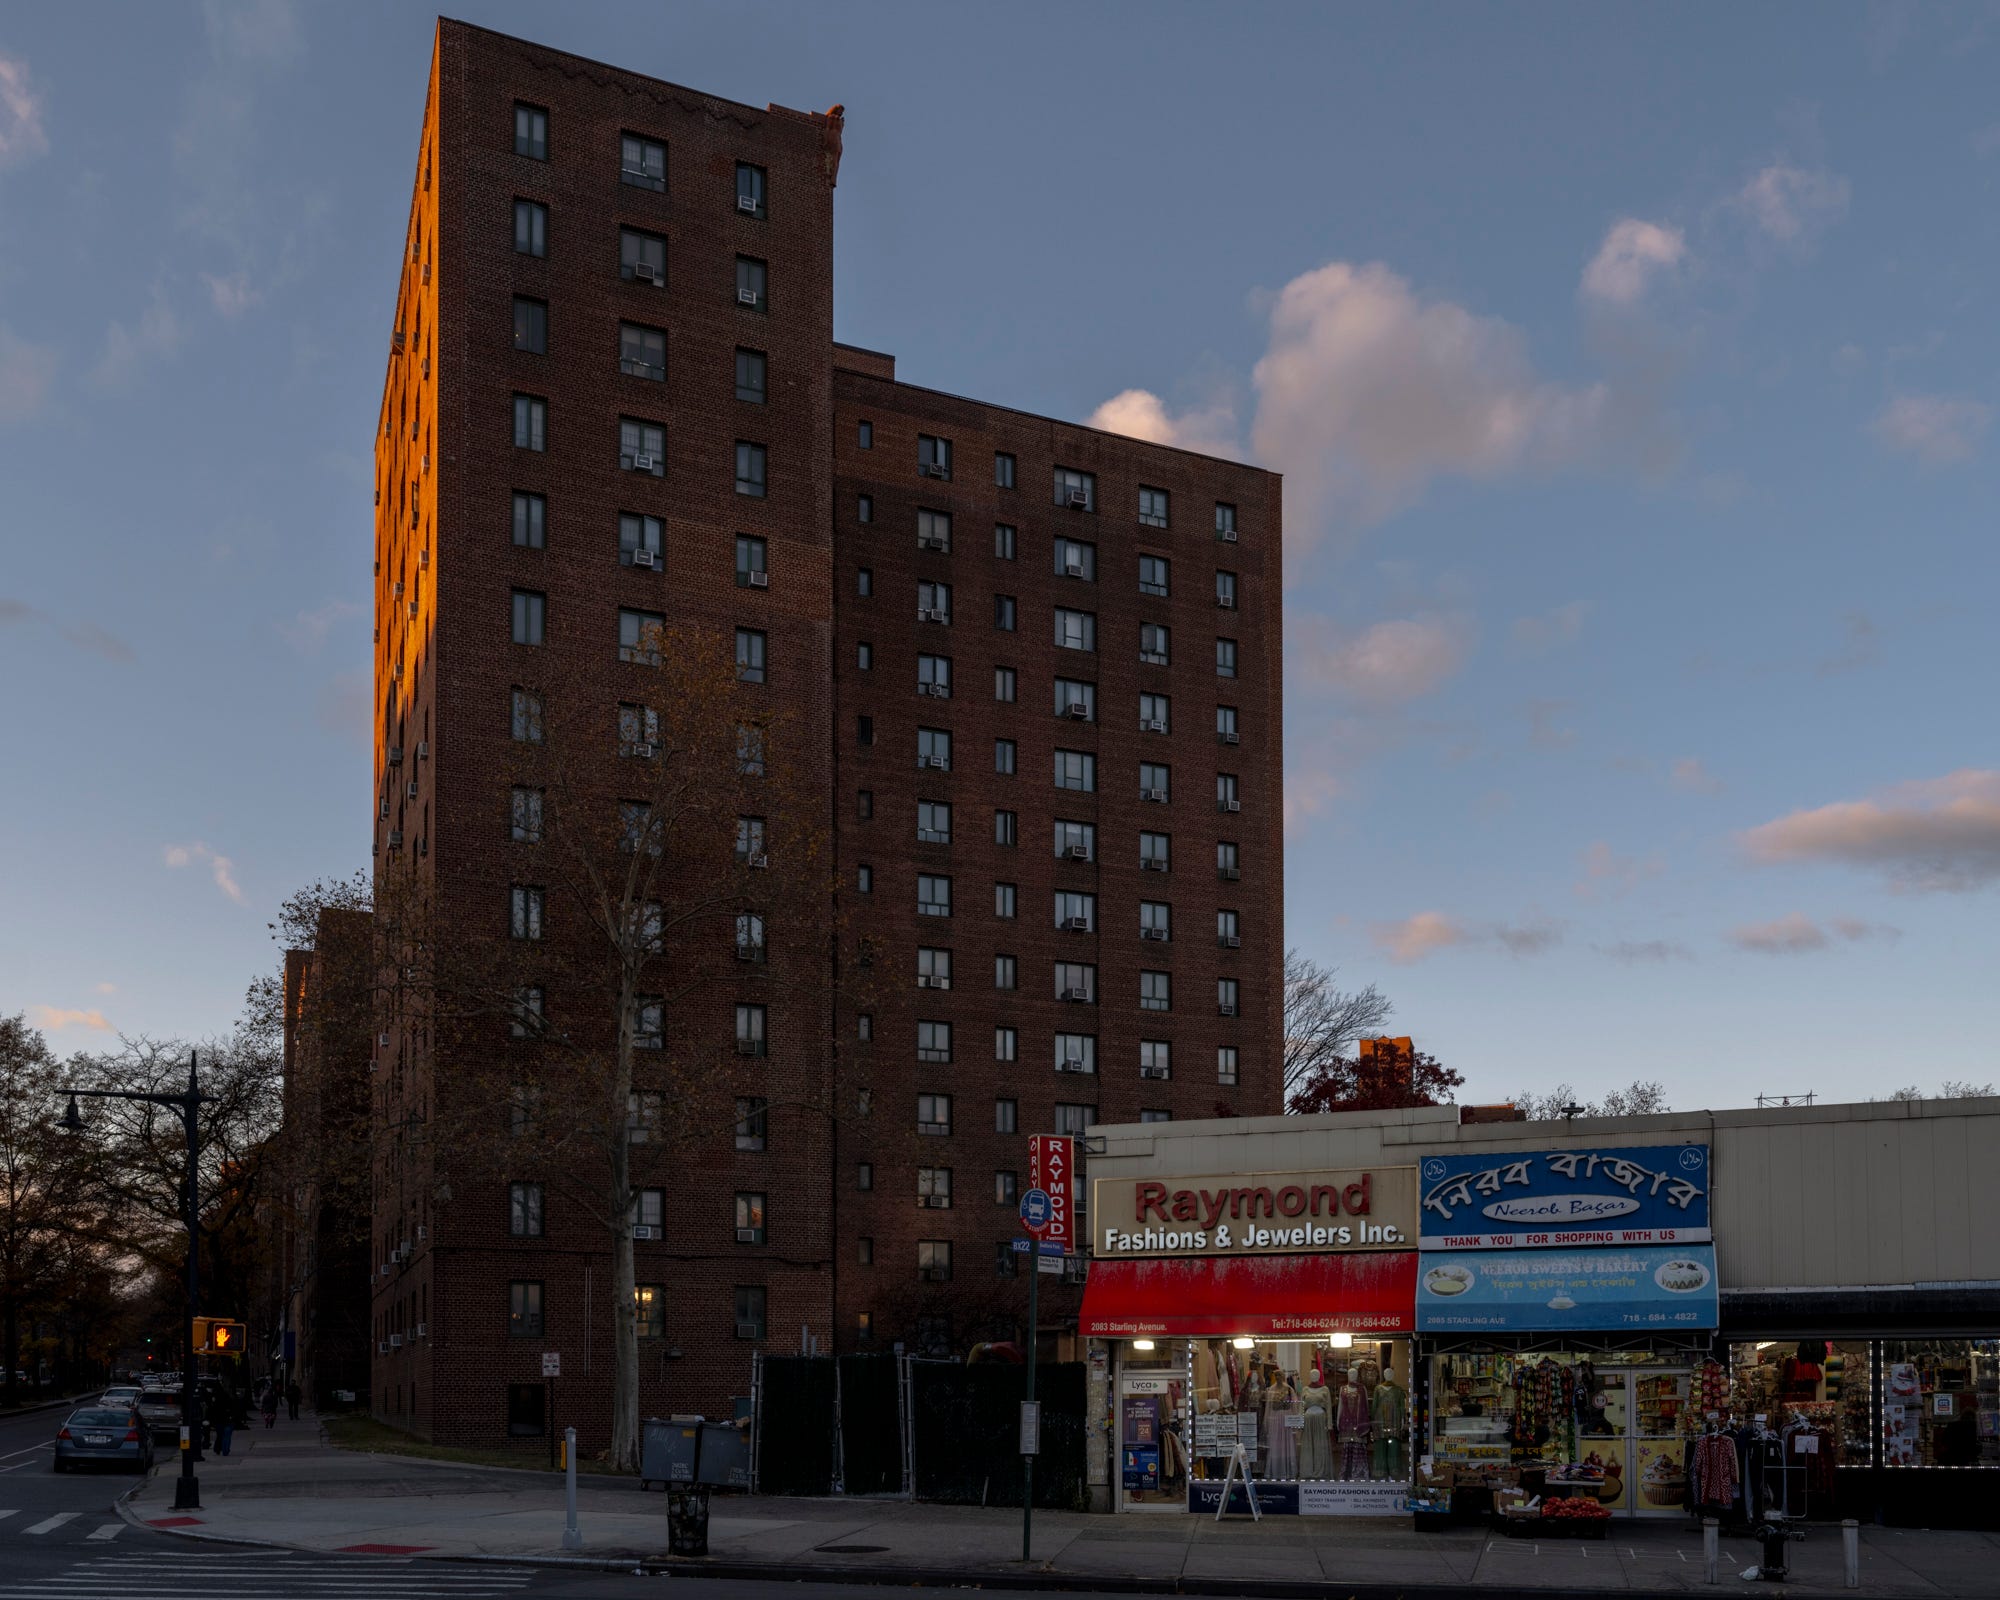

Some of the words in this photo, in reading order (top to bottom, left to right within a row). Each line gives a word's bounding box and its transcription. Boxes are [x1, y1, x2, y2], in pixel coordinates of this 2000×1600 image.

[1048, 1140, 1064, 1235] RAYMOND
[1546, 1153, 1704, 1210] বাজার
[1135, 1173, 1372, 1230] Raymond
[1105, 1226, 1207, 1251] Fashions
[1214, 1224, 1233, 1248] &
[1241, 1221, 1351, 1248] Jewelers
[1360, 1220, 1406, 1244] Inc.
[1443, 1235, 1481, 1247] THANK
[1490, 1234, 1513, 1246] YOU
[1526, 1233, 1548, 1244] FOR
[1554, 1231, 1614, 1243] SHOPPING
[1622, 1230, 1651, 1241] WITH
[1659, 1229, 1676, 1240] US
[1479, 1264, 1529, 1275] NEEROB
[1531, 1262, 1581, 1274] SWEETS
[1596, 1260, 1649, 1272] BAKERY
[1345, 1316, 1401, 1328] 718-684-6245
[1447, 1316, 1488, 1324] STARLING
[1489, 1316, 1506, 1324] AVE
[1622, 1314, 1640, 1322] 718
[1648, 1313, 1665, 1321] 684
[1674, 1312, 1697, 1320] 4822
[1090, 1322, 1108, 1331] 2083
[1109, 1321, 1137, 1333] Starling
[1131, 1380, 1152, 1390] Lyca
